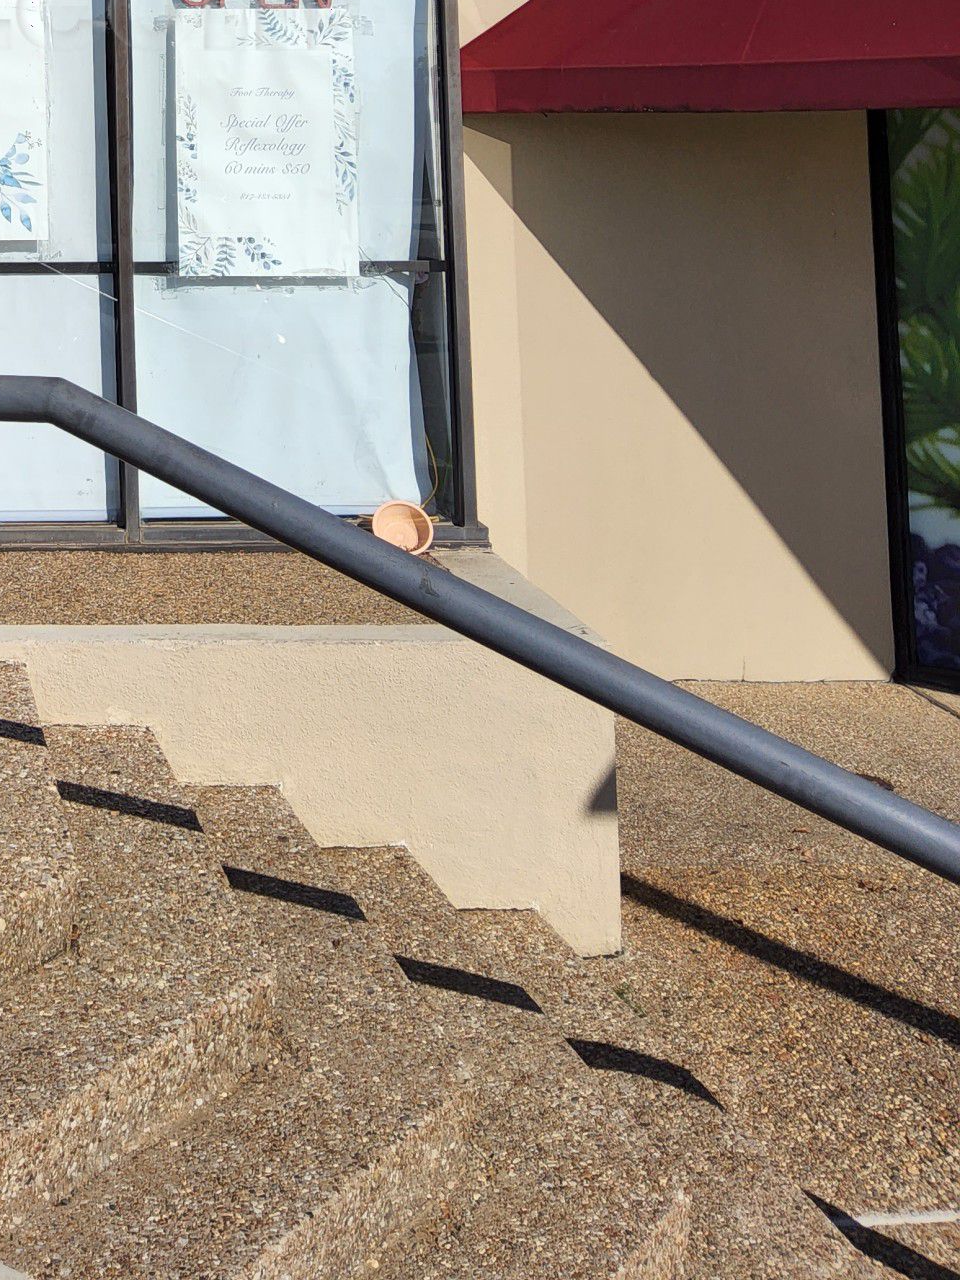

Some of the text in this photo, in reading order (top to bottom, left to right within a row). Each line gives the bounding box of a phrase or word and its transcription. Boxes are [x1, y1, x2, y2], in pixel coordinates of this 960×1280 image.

[220, 114, 308, 132] Special Offer
[224, 137, 306, 156] Reflexology
[224, 160, 243, 175] 60
[243, 163, 276, 174] mins
